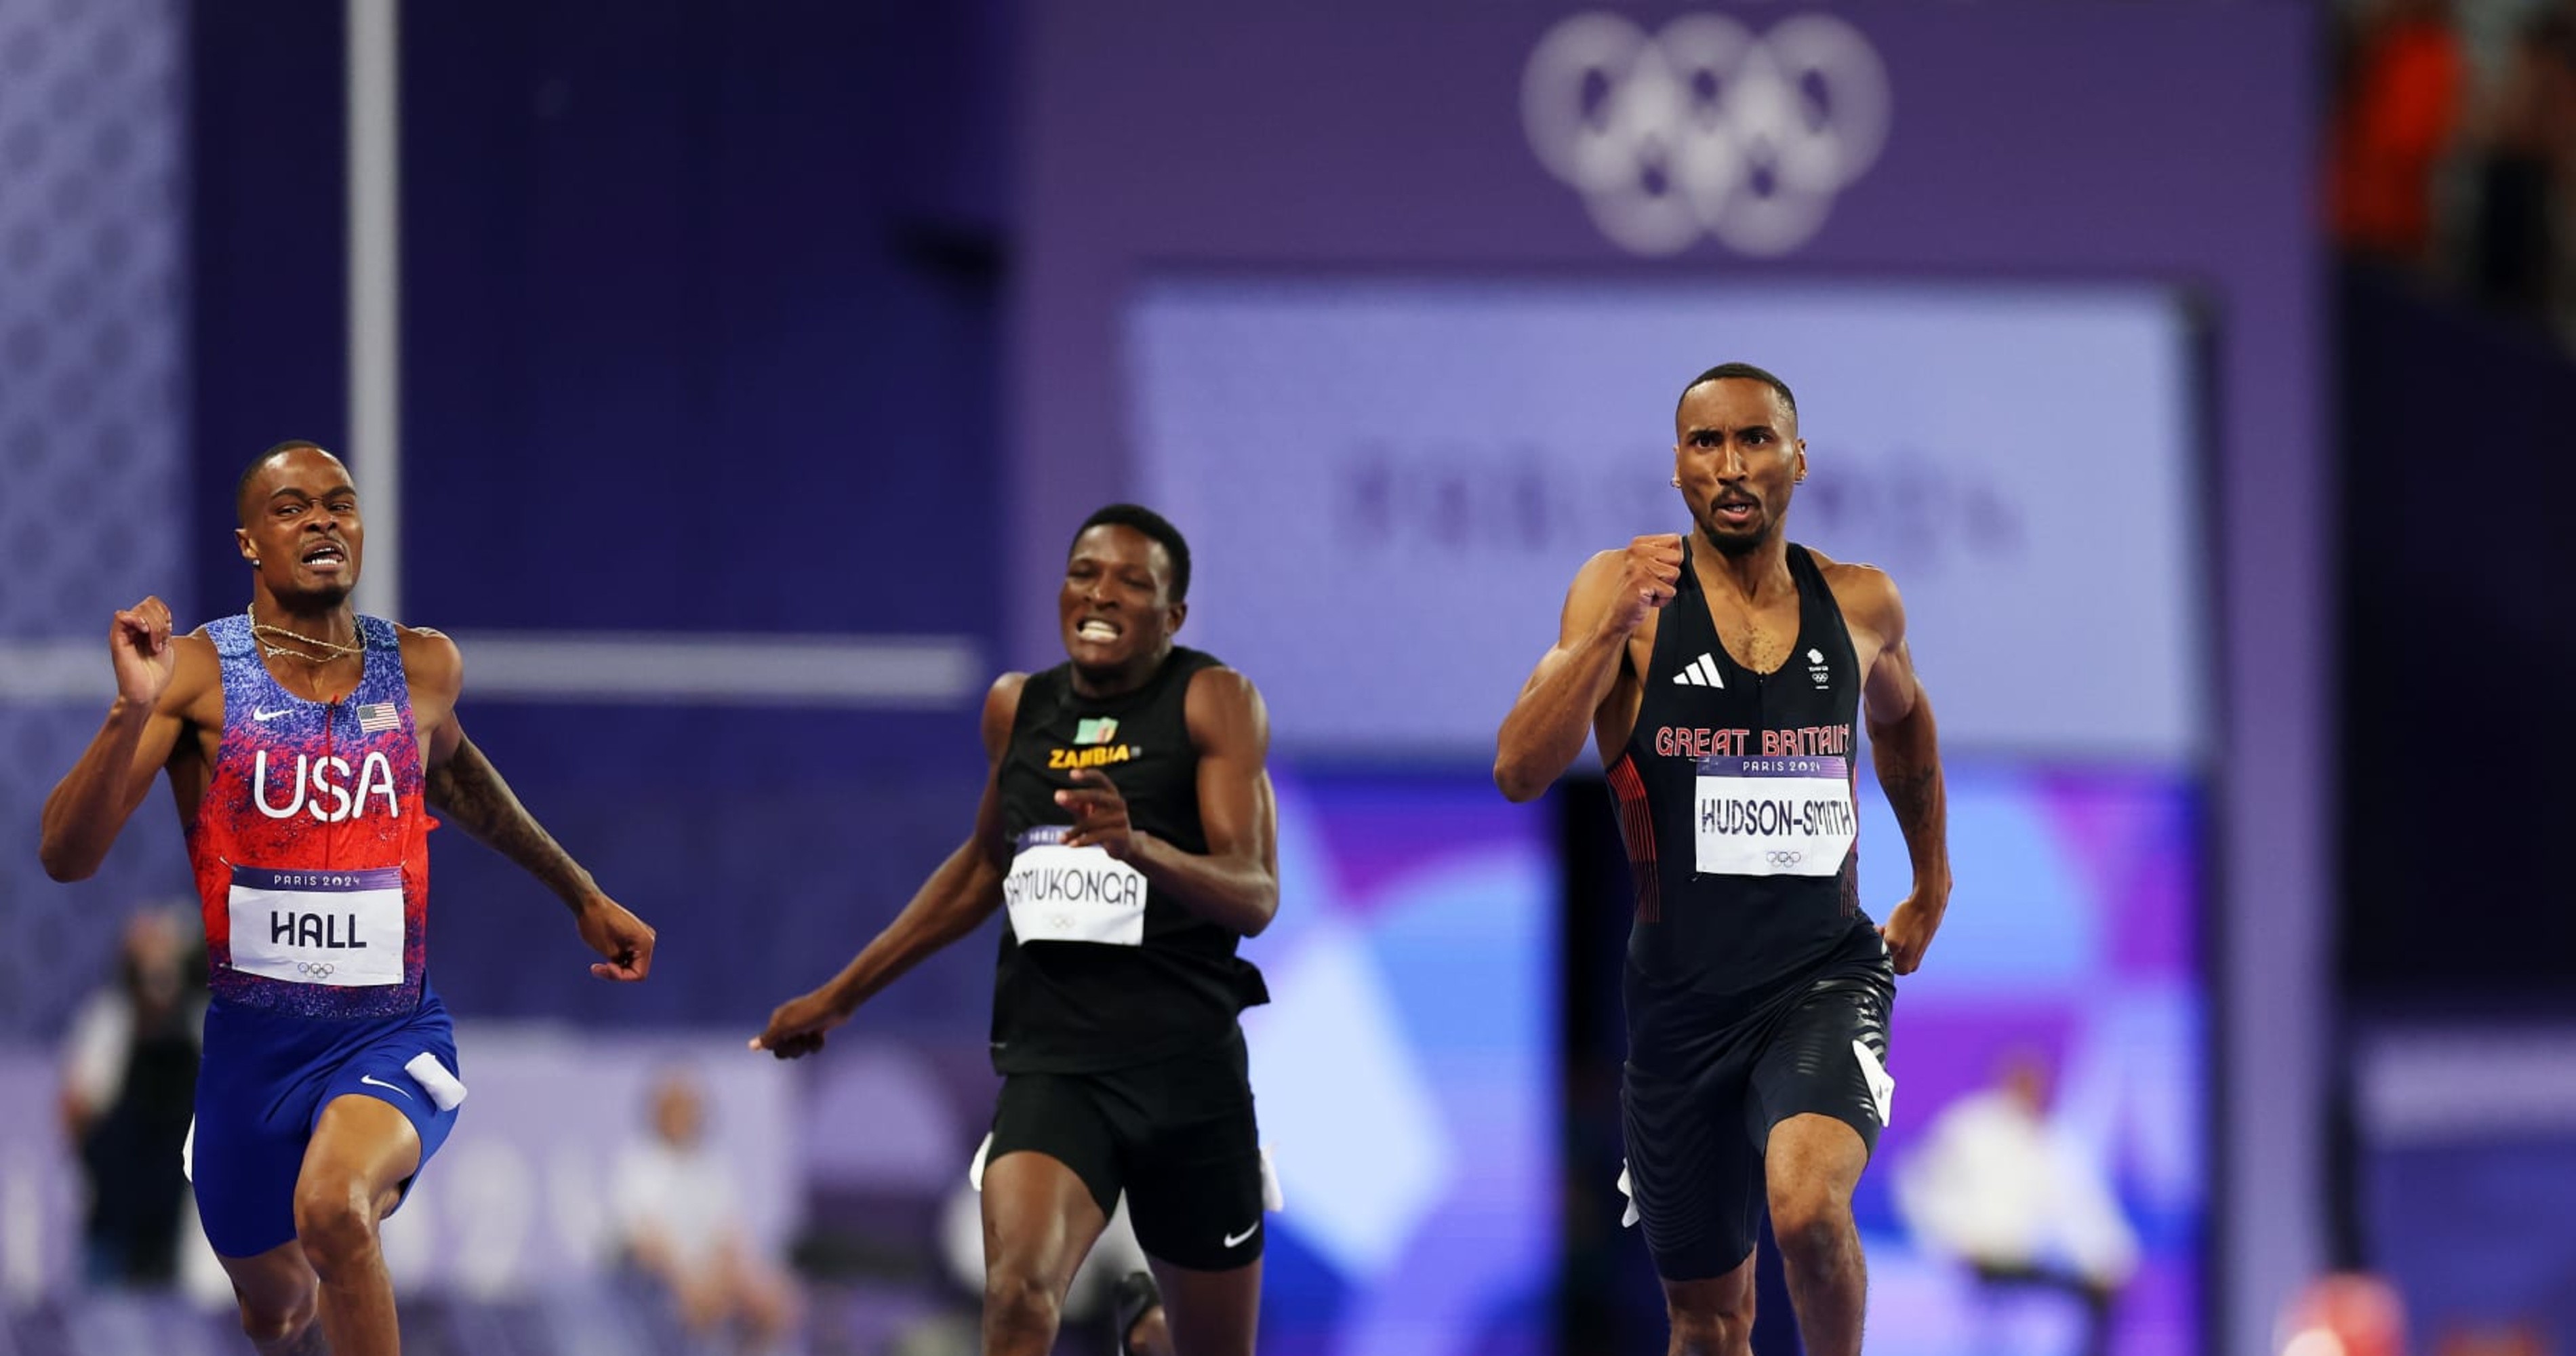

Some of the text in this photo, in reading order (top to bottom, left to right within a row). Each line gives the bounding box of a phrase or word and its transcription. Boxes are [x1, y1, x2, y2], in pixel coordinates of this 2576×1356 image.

[1048, 744, 1129, 769] ZAMBIA
[1655, 723, 1850, 757] GREAT BRITAIN
[1743, 761, 1784, 772] PARIS
[253, 750, 399, 822] USA
[1702, 799, 1853, 837] HUDSON-SMITH
[274, 874, 361, 887] PARIS 2024
[271, 911, 367, 949] HALL
